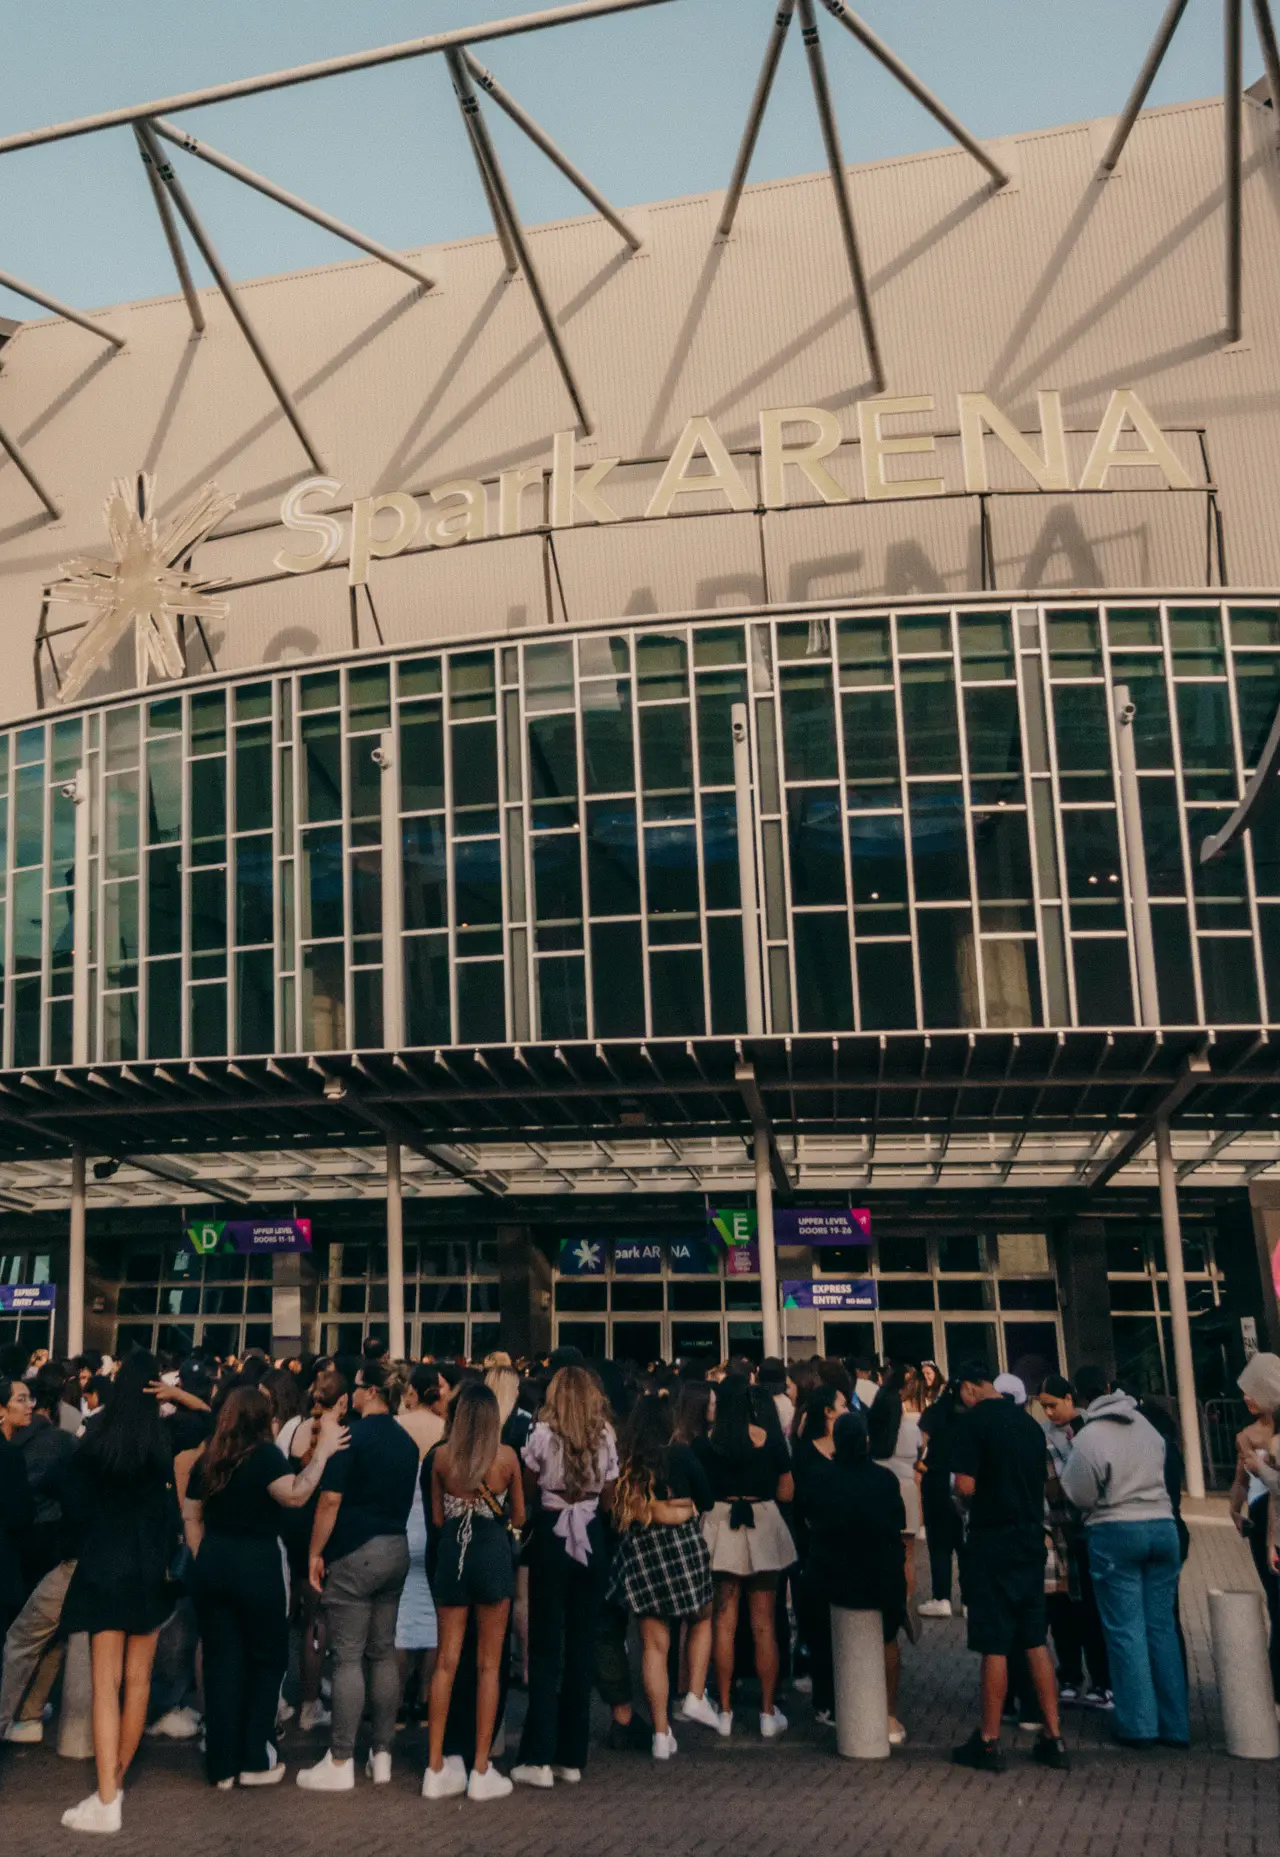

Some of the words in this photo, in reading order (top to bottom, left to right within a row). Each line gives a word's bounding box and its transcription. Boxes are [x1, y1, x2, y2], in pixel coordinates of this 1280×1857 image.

[272, 430, 622, 586] Spark
[644, 388, 1196, 519] ARENA
[798, 1217, 824, 1225] UPPER
[825, 1217, 848, 1225] LEVEL
[733, 1217, 750, 1240] E
[202, 1228, 217, 1249] D
[615, 1245, 640, 1258] park
[642, 1245, 691, 1258] ARNA
[812, 1284, 852, 1294] EXPRESS
[813, 1295, 843, 1304] ENTRY
